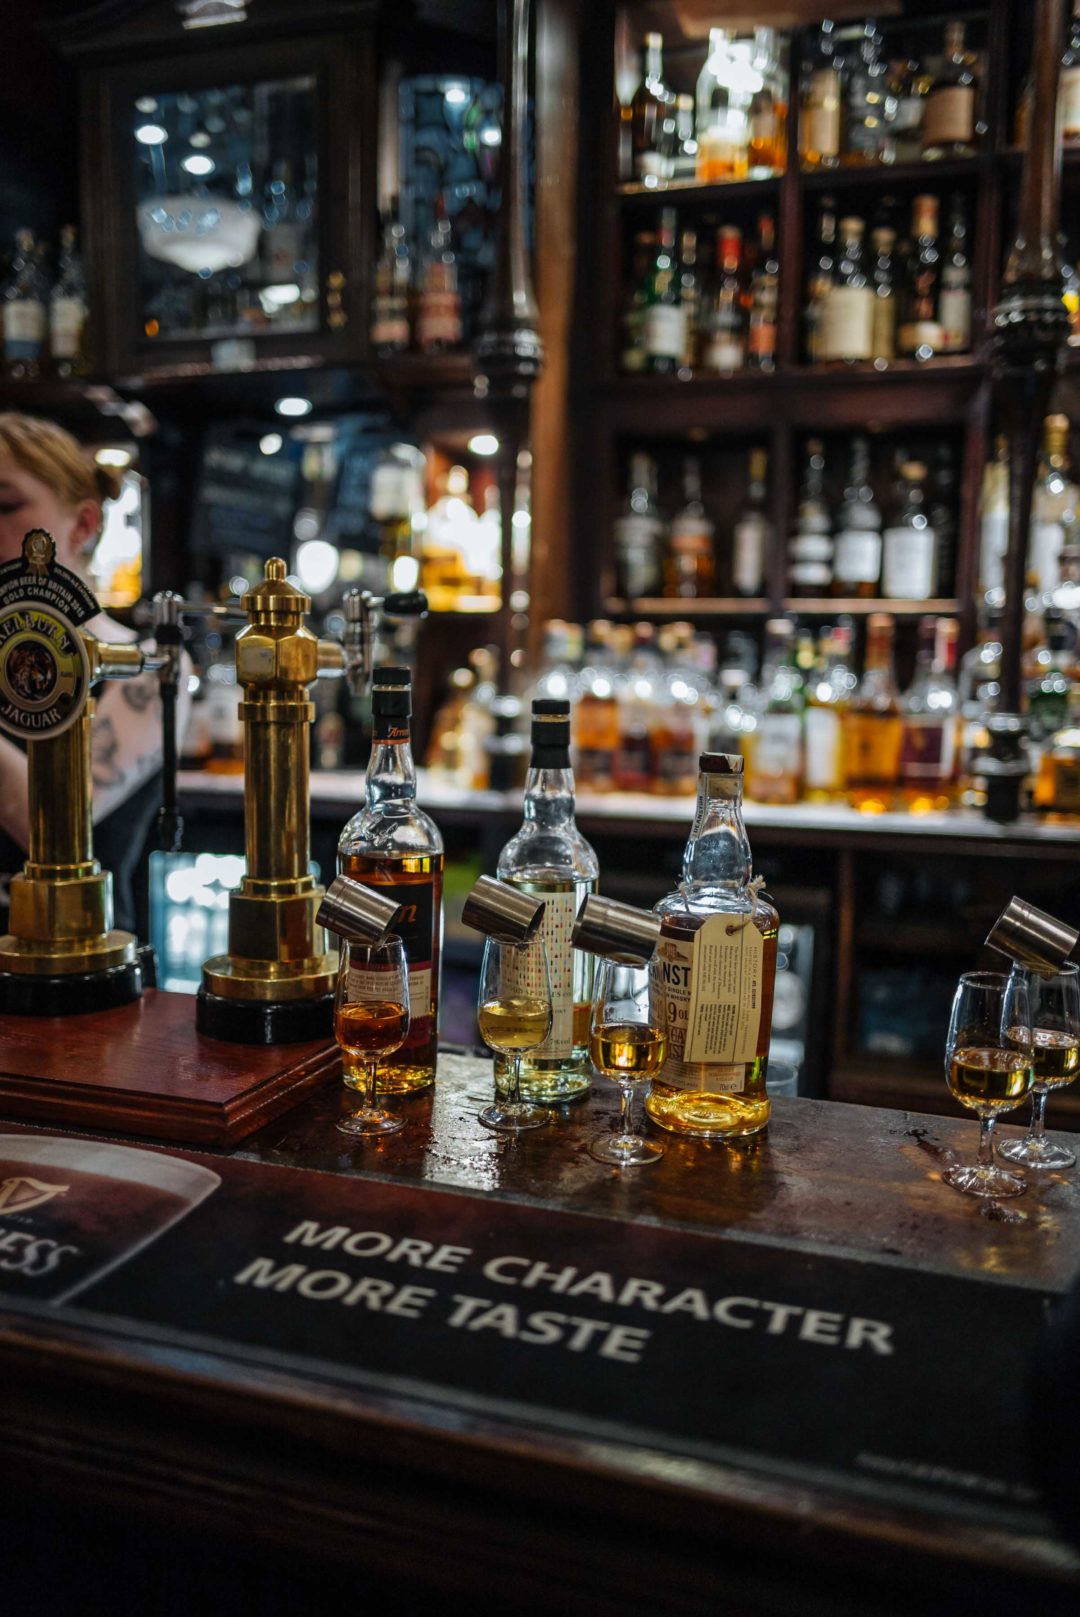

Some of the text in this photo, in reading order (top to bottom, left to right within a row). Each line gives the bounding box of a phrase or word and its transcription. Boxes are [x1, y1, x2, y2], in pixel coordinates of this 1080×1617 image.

[3, 586, 71, 614] GOLD CHAMPION
[47, 579, 74, 602] BRITAIN
[1, 703, 61, 729] JAGUAR
[283, 1219, 896, 1356] MORE CHARACTER
[233, 1256, 653, 1364] MORE TASTE
